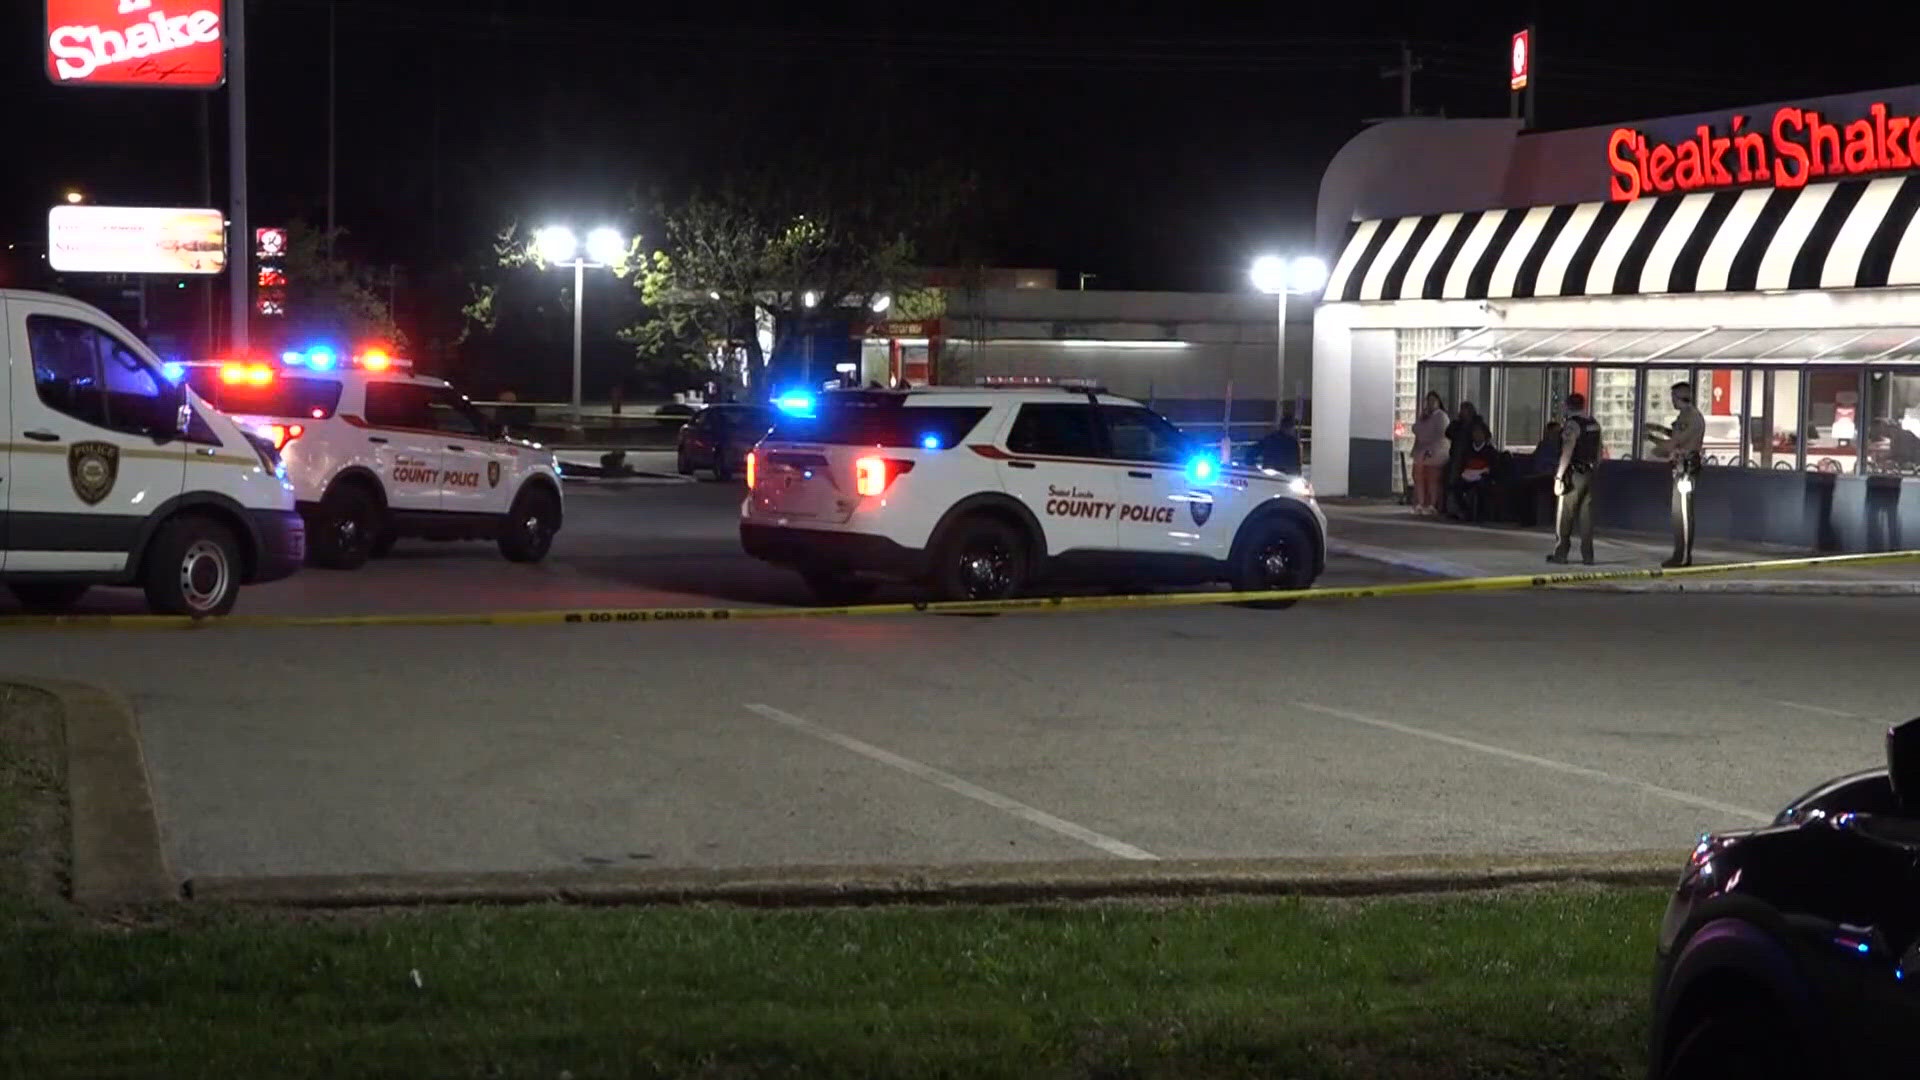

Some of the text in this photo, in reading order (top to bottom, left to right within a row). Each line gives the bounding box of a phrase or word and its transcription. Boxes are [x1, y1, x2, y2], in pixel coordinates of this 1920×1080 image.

[49, 10, 220, 80] Shake
[74, 443, 110, 458] POLICE
[393, 467, 439, 484] COUNTY
[442, 470, 480, 487] POLICE
[1046, 499, 1116, 520] COUNTY
[1119, 504, 1176, 524] POLICE
[589, 612, 612, 623] DO
[616, 611, 648, 622] NOT
